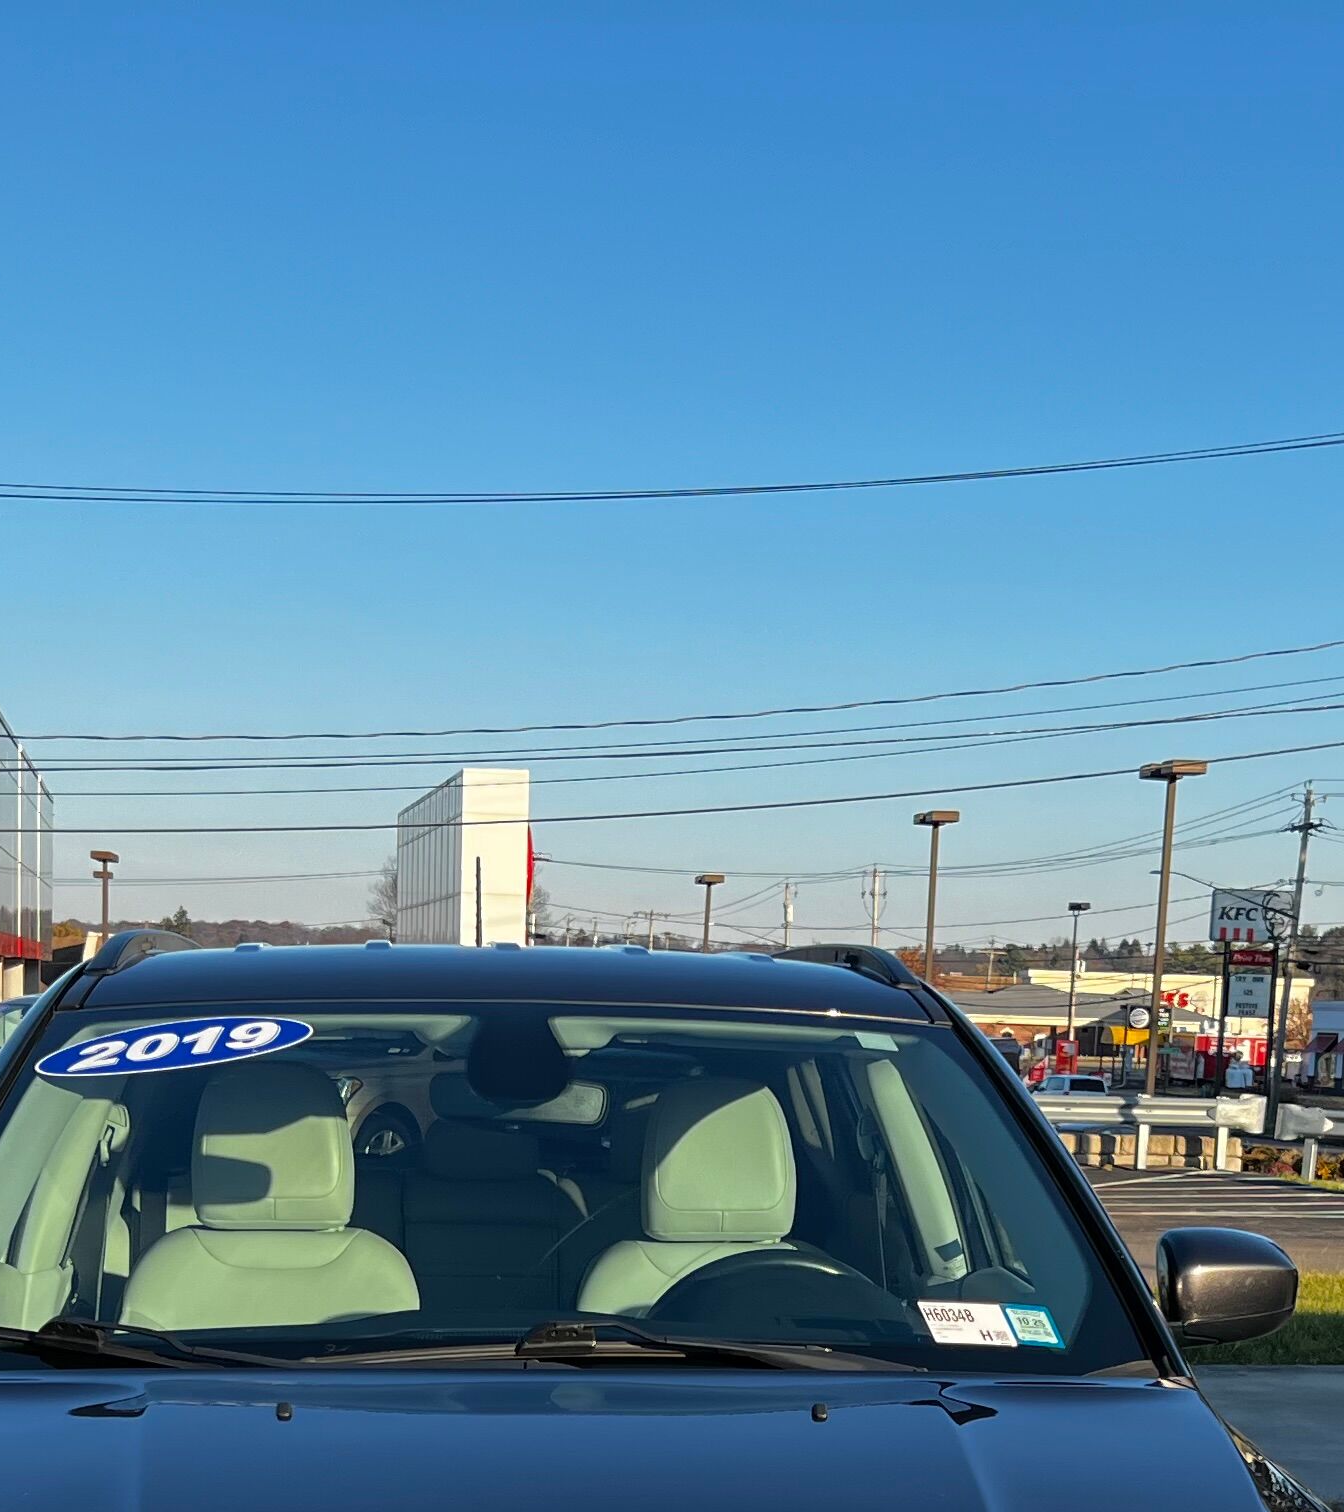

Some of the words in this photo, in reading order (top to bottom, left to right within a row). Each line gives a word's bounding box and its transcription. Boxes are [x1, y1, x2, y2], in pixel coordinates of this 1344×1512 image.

[1218, 907, 1258, 921] KFC
[67, 1021, 281, 1072] 2019
[979, 1330, 994, 1341] H
